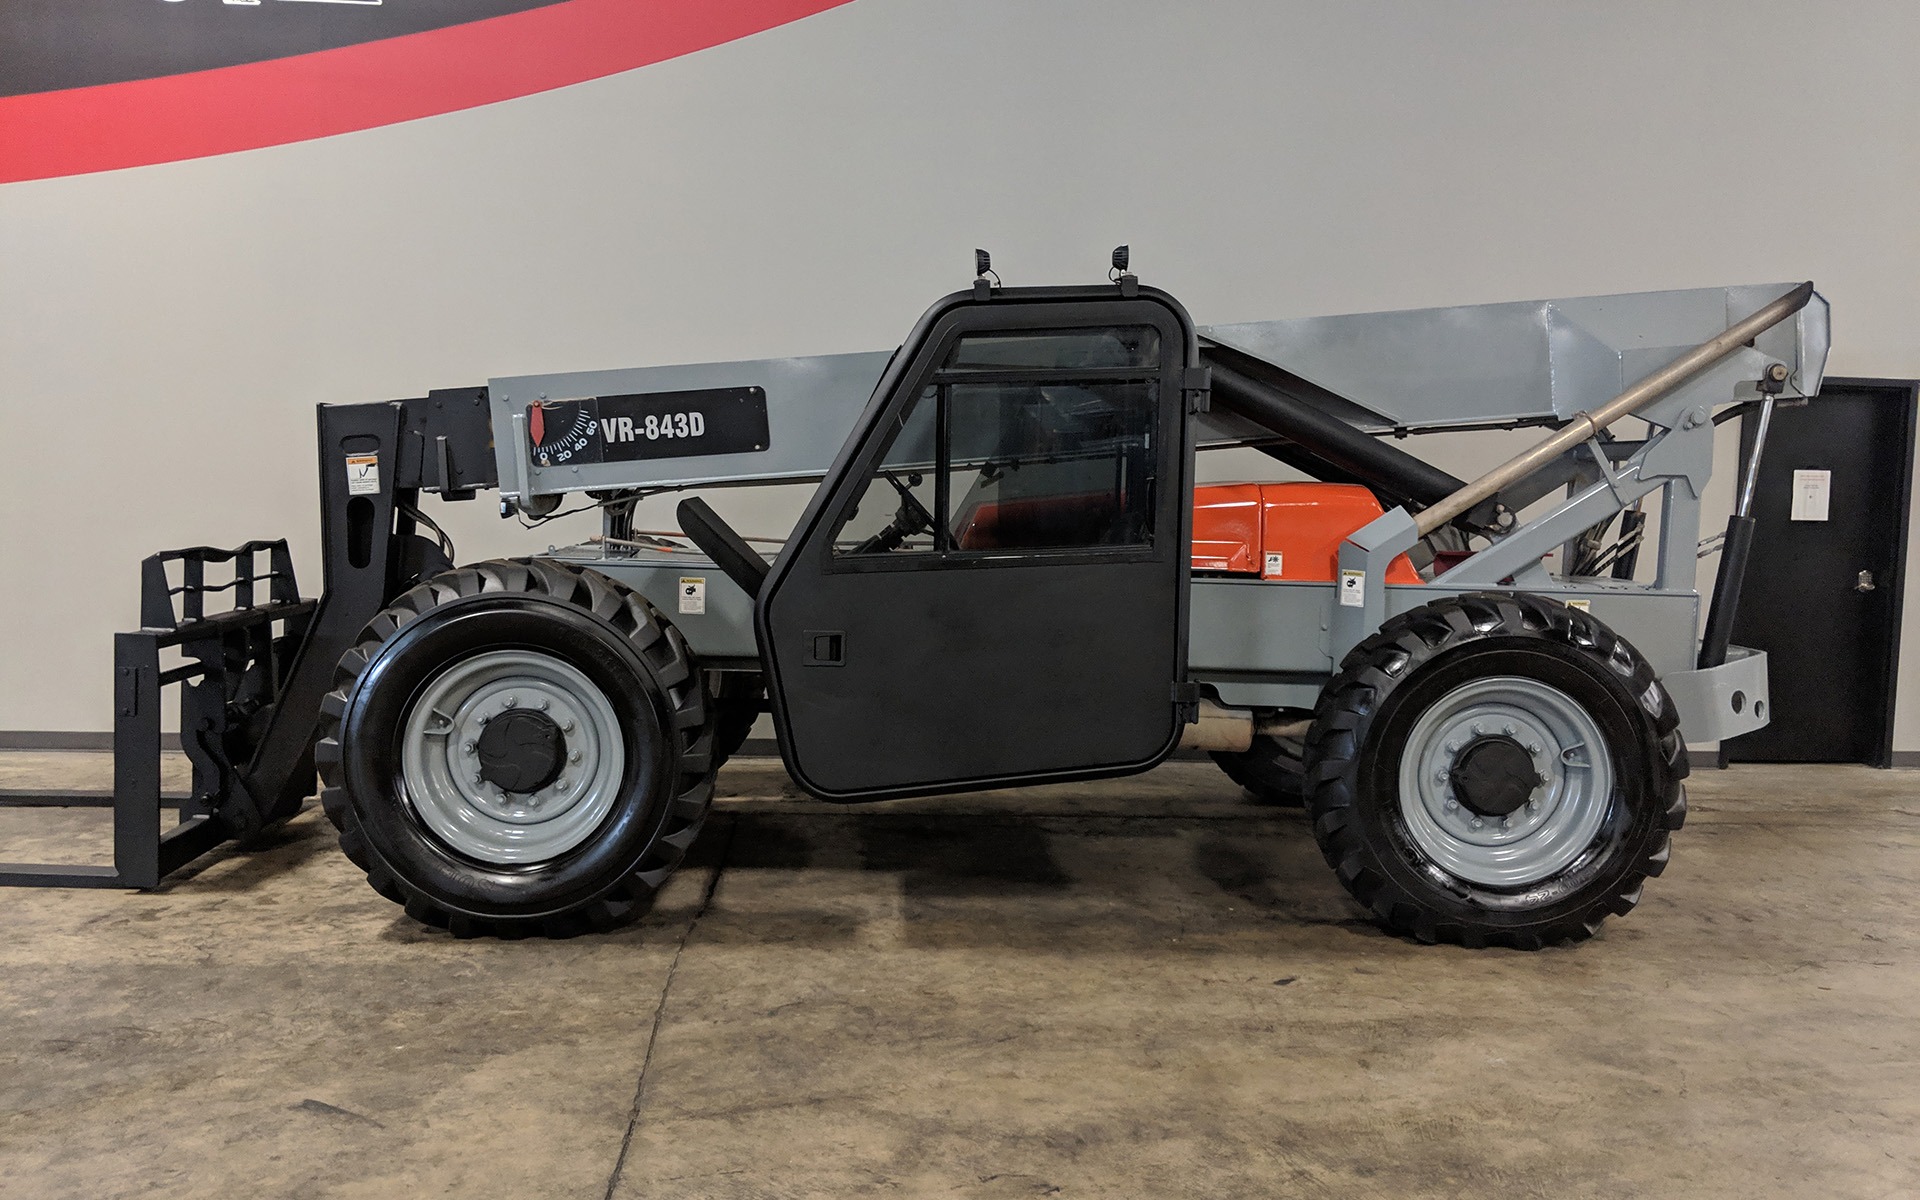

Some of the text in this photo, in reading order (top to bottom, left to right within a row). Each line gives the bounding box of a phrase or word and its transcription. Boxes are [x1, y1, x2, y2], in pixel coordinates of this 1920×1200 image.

[539, 420, 598, 462] 0 20 40 60
[600, 412, 705, 443] VR-843D
